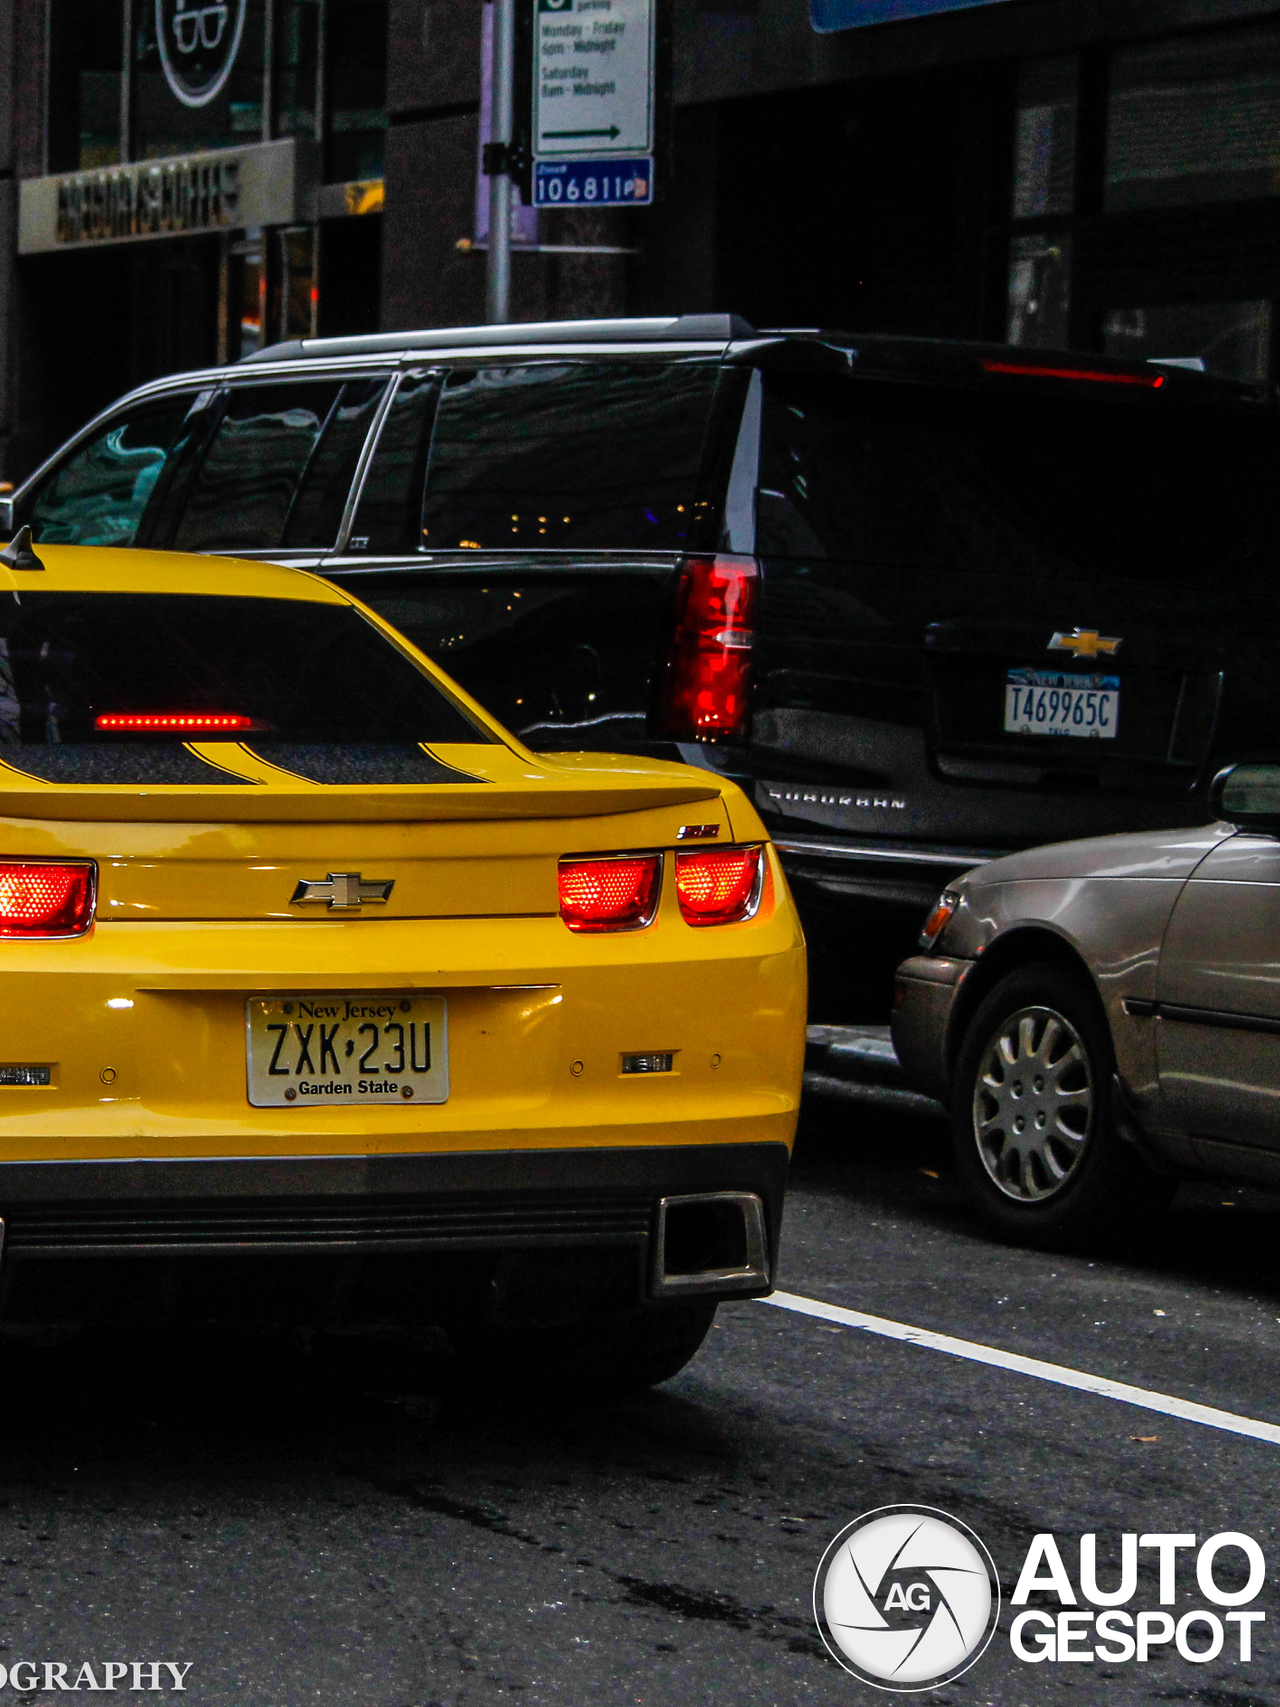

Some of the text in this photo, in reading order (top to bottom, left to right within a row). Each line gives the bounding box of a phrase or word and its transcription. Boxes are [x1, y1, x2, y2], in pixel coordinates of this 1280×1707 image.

[542, 24, 582, 37] Monday
[592, 20, 625, 36] Friday
[573, 38, 616, 53] Midnight
[542, 66, 588, 80] Saturday
[573, 81, 616, 96] Midnight
[538, 175, 621, 200] 106811
[1012, 687, 1110, 727] T469965C
[768, 789, 906, 810] SUBURBAN
[298, 1000, 397, 1021] New Jersey
[298, 1080, 398, 1095] Garden State
